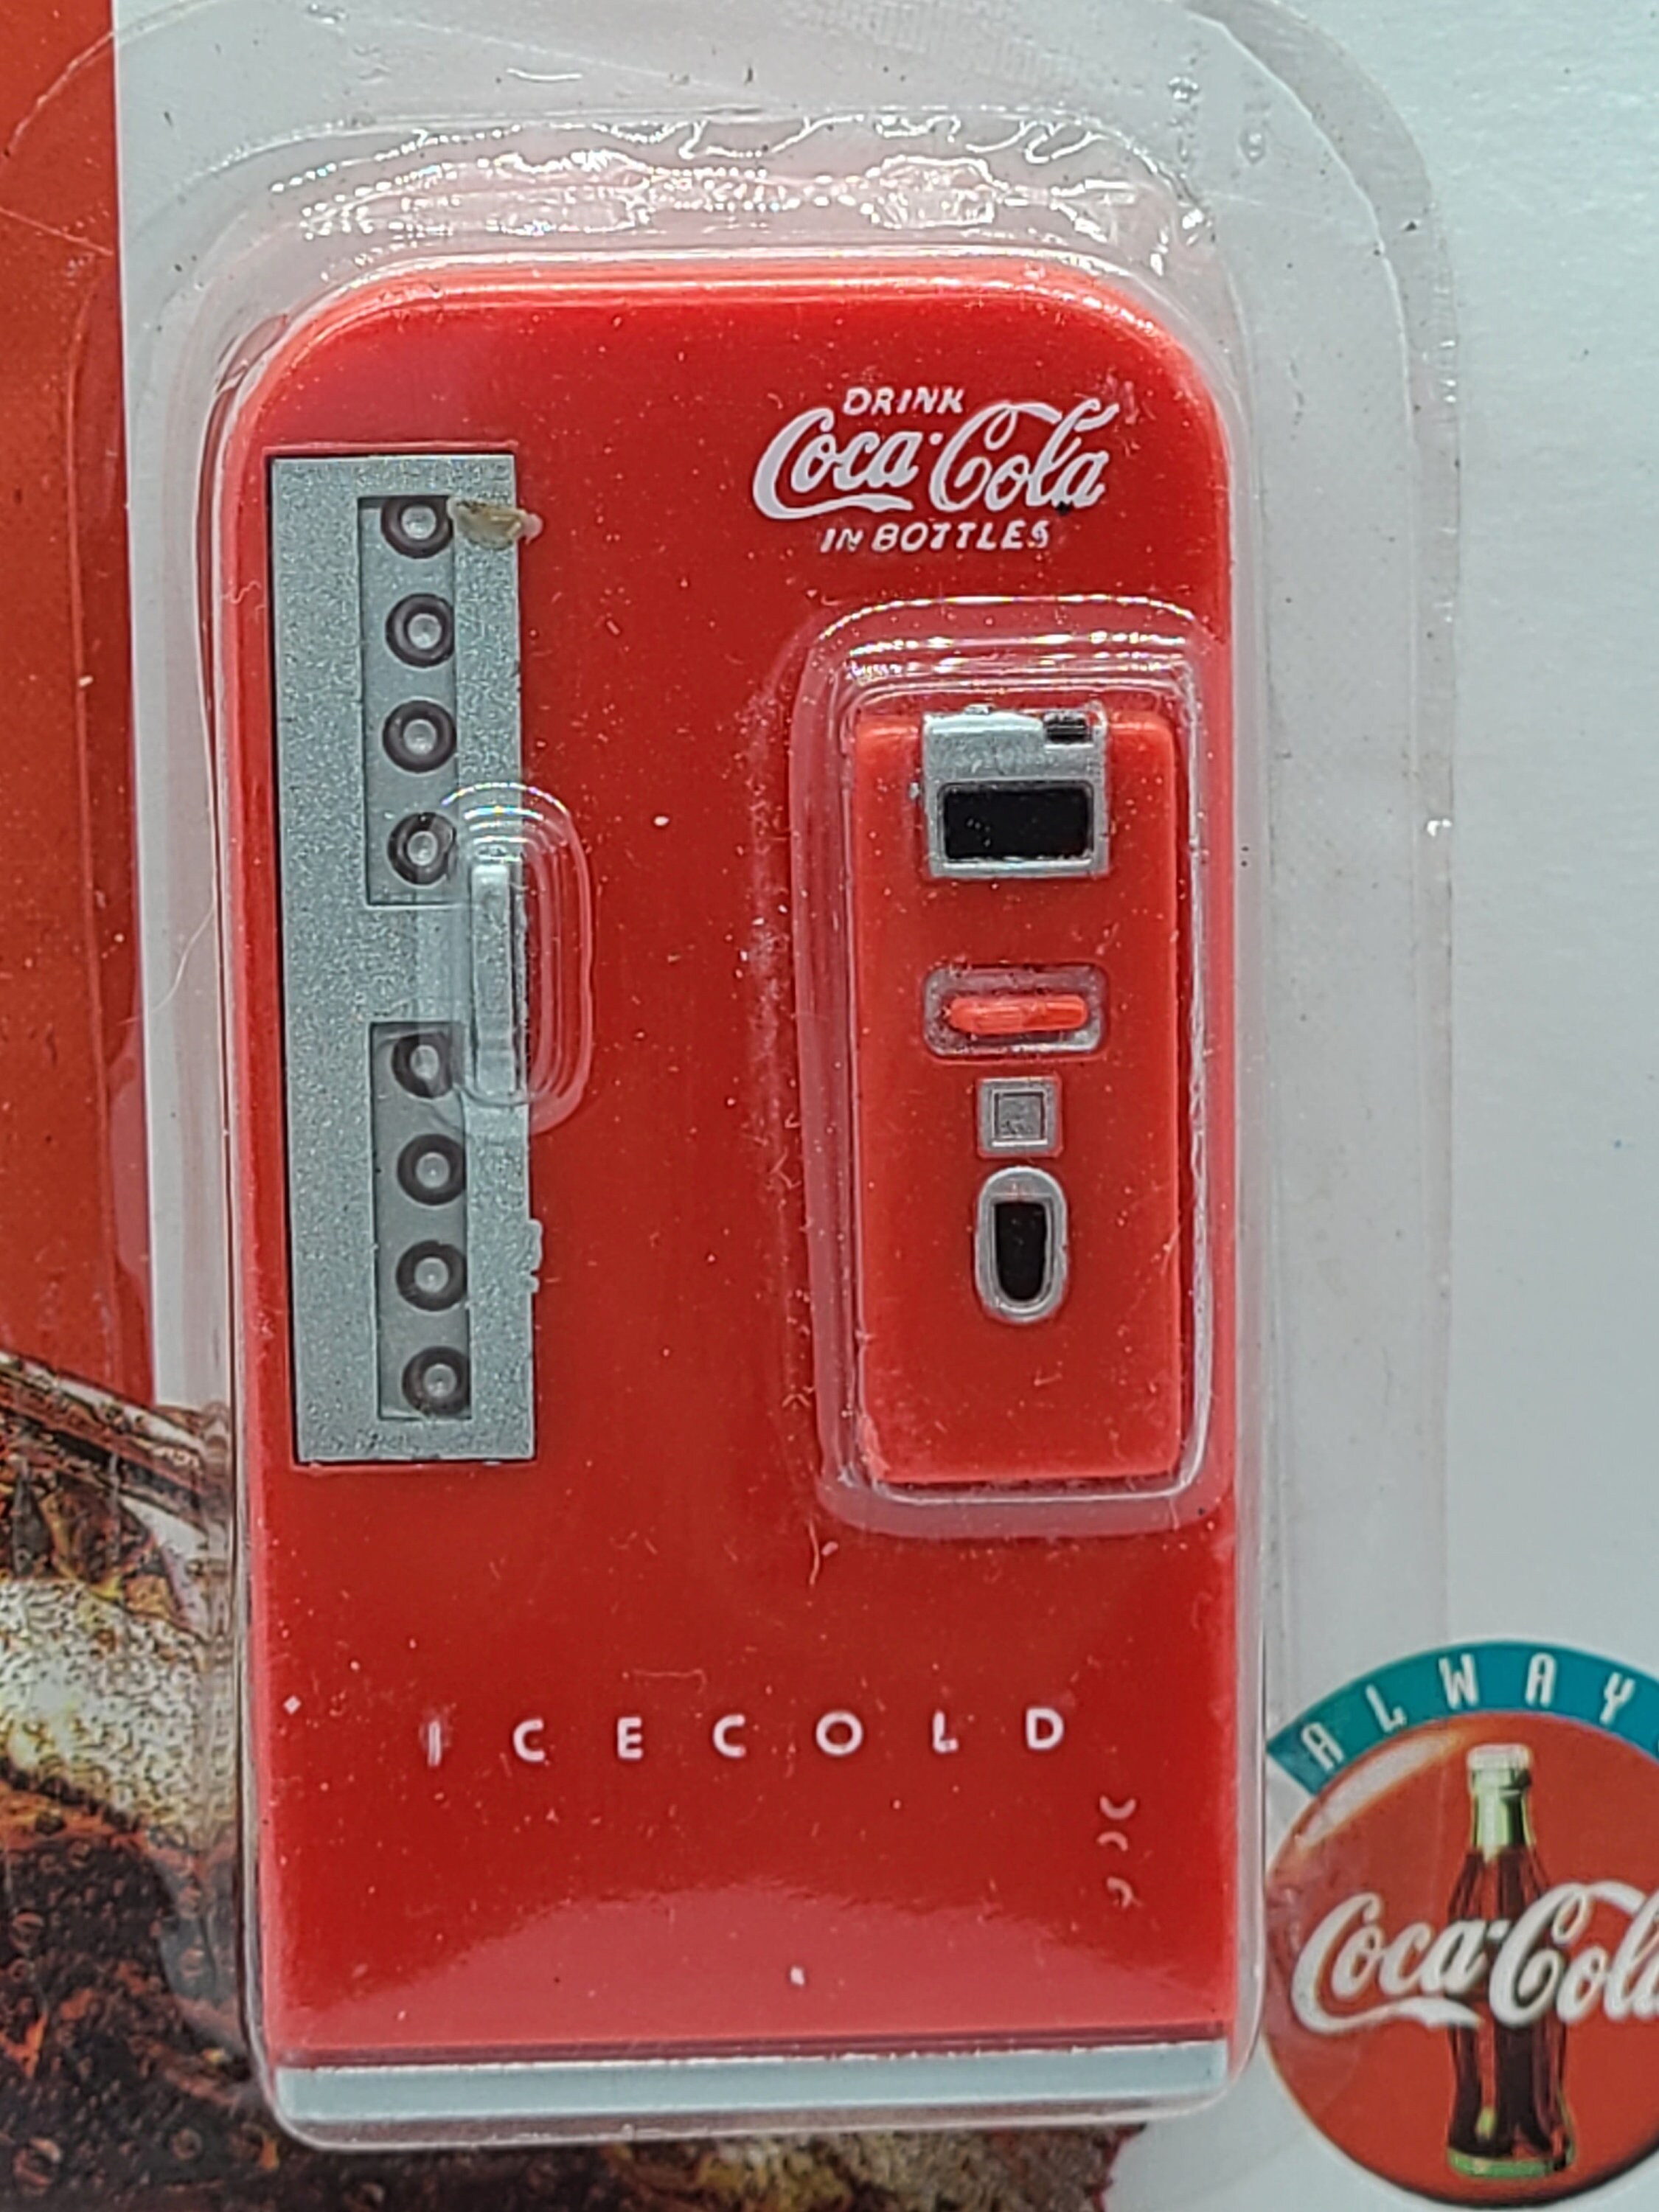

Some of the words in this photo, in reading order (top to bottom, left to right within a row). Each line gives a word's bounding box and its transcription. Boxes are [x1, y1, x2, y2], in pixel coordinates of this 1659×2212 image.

[842, 386, 964, 416] DRINK
[820, 527, 863, 553] IN
[871, 519, 1050, 552] BOTTLES
[1300, 1652, 1659, 1771] ALWAY
[427, 1717, 643, 1767] ICE
[713, 1706, 1065, 1758] COLD
